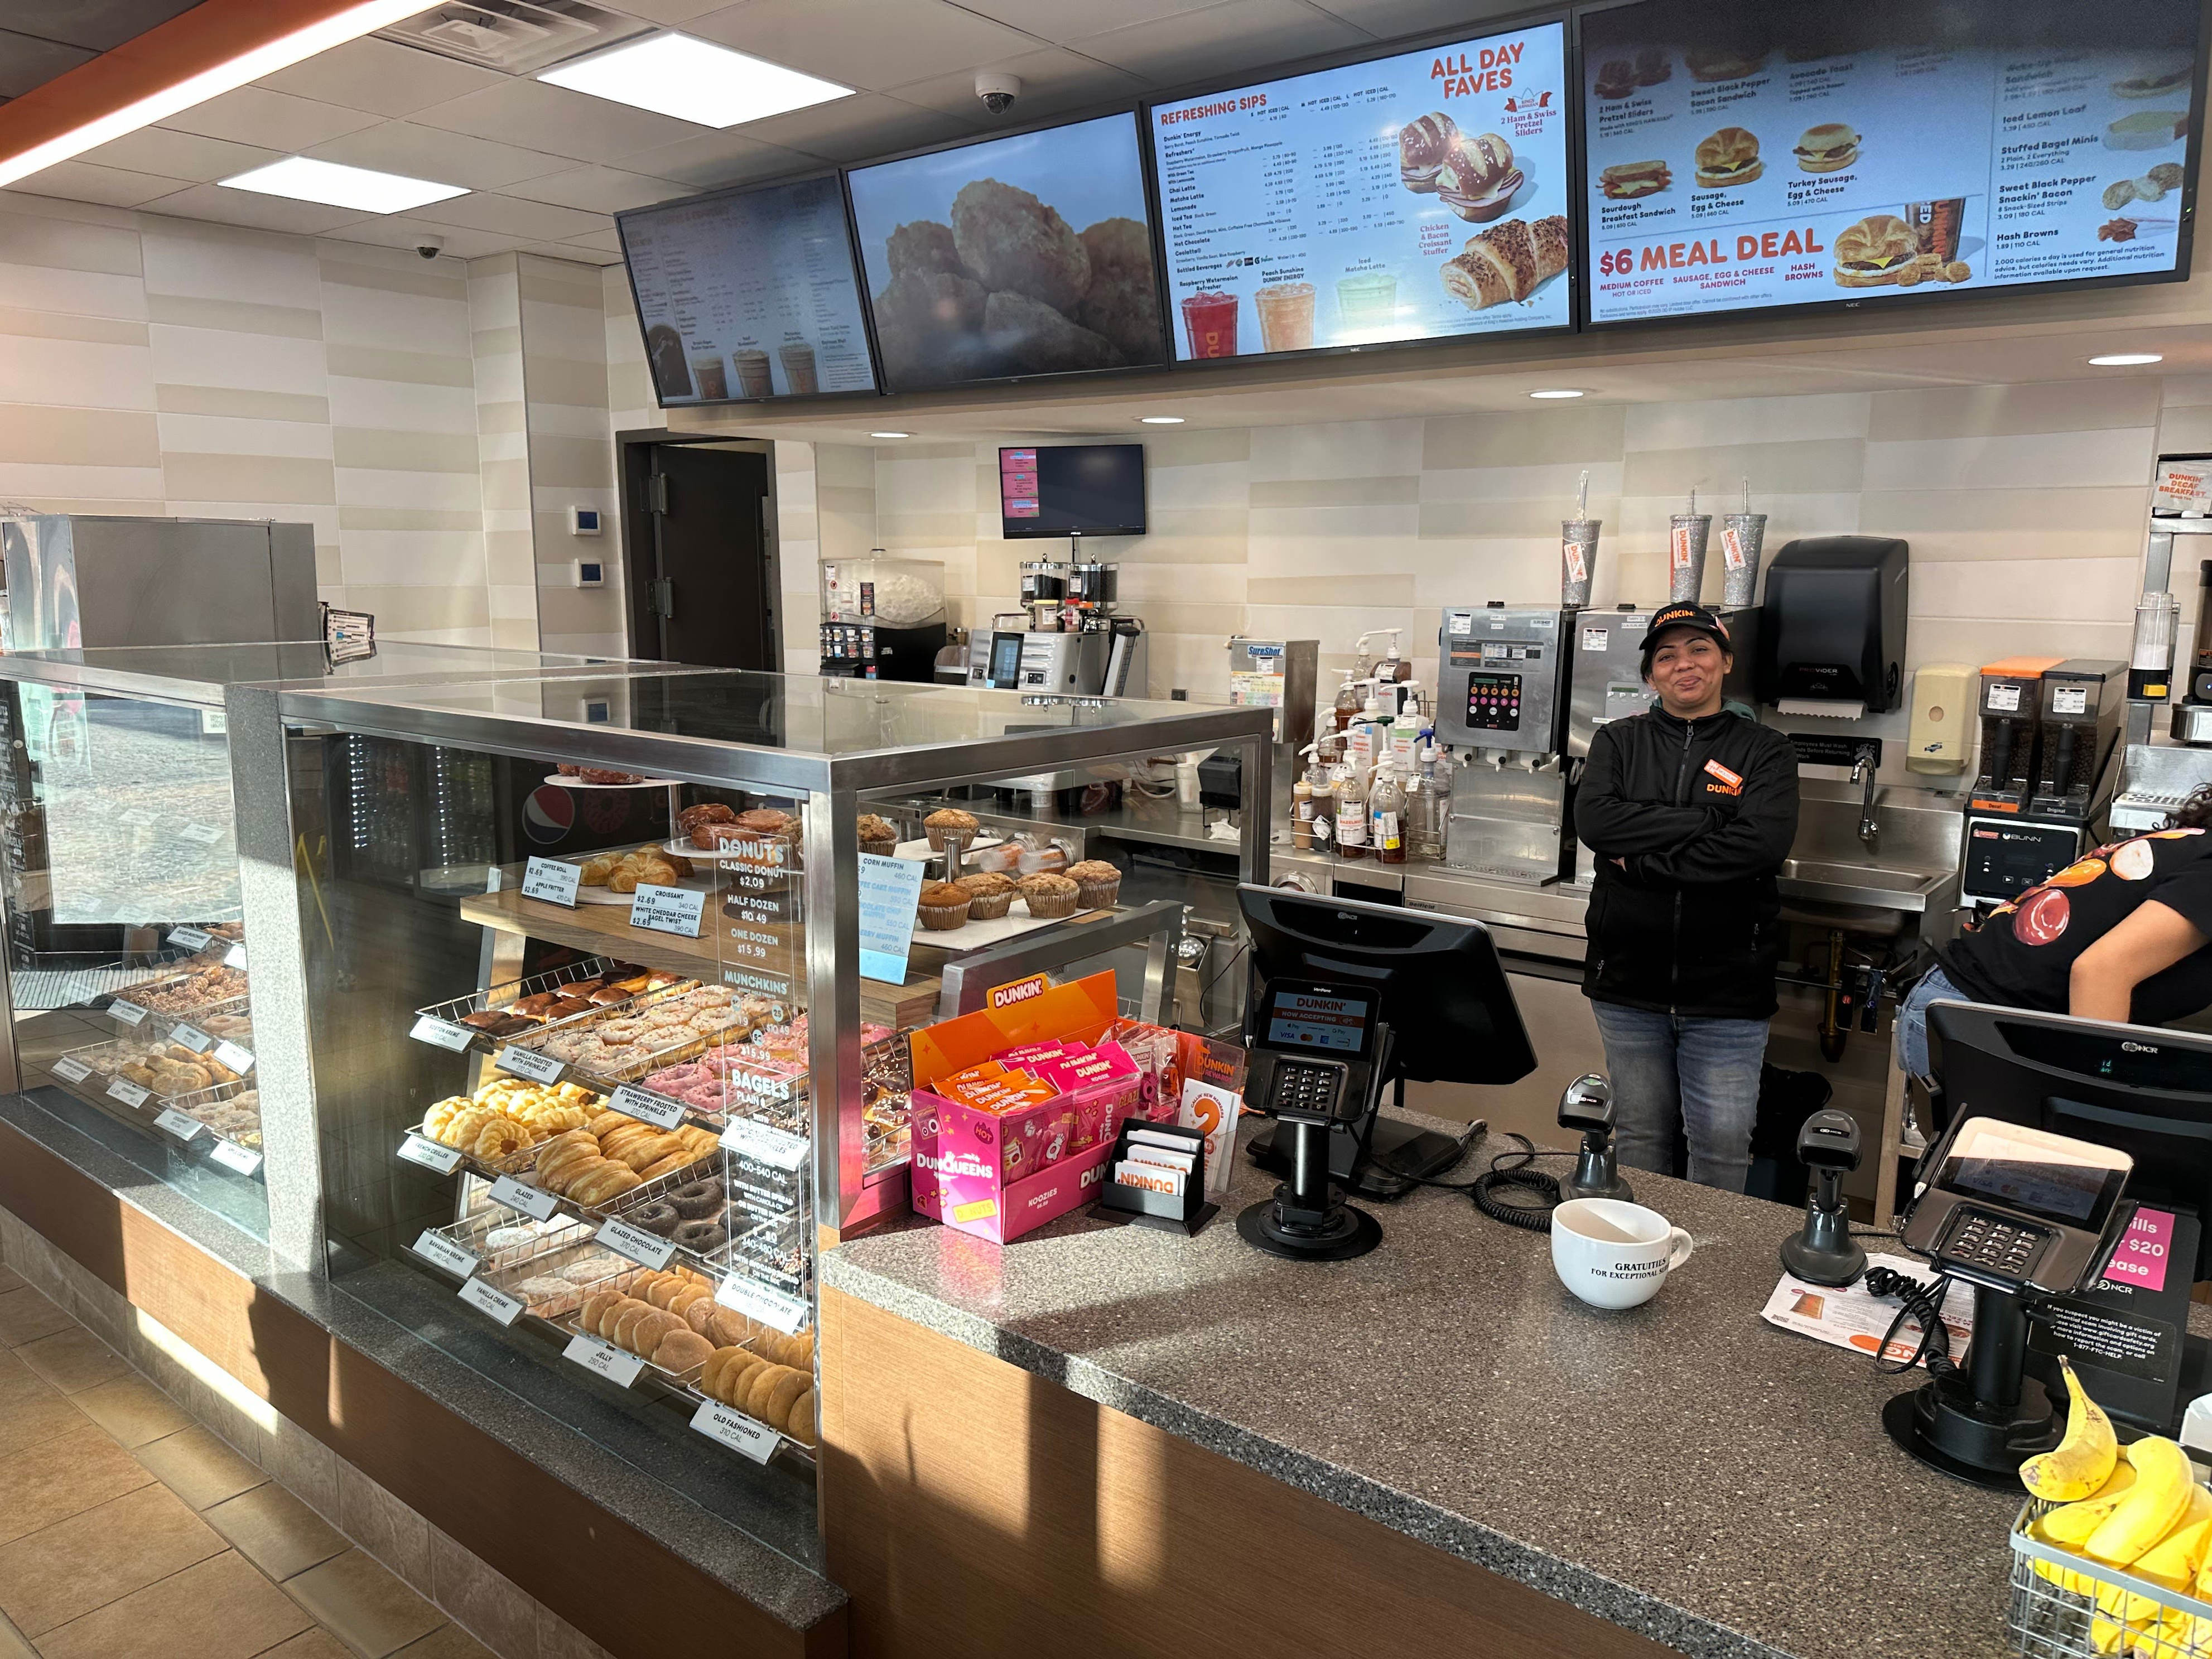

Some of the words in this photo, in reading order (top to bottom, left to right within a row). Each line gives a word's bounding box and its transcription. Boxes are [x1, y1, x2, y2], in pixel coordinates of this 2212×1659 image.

[1430, 54, 1473, 80] ALL
[1480, 42, 1525, 70] DAY
[1444, 68, 1512, 99] FAVES
[1161, 100, 1236, 126] REFRESHING
[1240, 94, 1267, 110] SIPS
[2003, 113, 2024, 123] Iced
[2026, 109, 2060, 120] Lemon
[2062, 104, 2087, 115] Loaf
[1514, 119, 1543, 129] Pretzel
[1515, 127, 1543, 137] Sliders
[2002, 142, 2040, 155] Stuffed
[2041, 139, 2069, 150] Bagel
[2072, 135, 2098, 145] Minis
[1788, 180, 1816, 190] Turkey
[1818, 175, 1857, 185] Sausage,
[1999, 182, 2029, 192] Sweet
[2031, 179, 2058, 189] Black
[2061, 175, 2097, 187] Pepper
[1691, 192, 1727, 201] Sausage,
[1787, 191, 1803, 200] Egg
[1814, 186, 1844, 195] Cheese
[1999, 193, 2039, 204] Snackin'
[2042, 189, 2073, 198] Bacon
[1601, 203, 1641, 214] Sourdough
[1716, 199, 1744, 208] Cheese
[1602, 213, 1638, 223] Breakfast
[1640, 208, 1675, 218] Sandwich
[1420, 224, 1449, 232] Chicken
[1997, 232, 2021, 242] Hash
[2023, 229, 2059, 239] Browns
[1419, 239, 1452, 248] Croissant
[1423, 247, 1448, 255] Stuffer
[1600, 248, 1633, 277] $6
[1640, 239, 1728, 272] MEAL
[1737, 228, 1824, 261] DEAL
[1791, 263, 1815, 272] HASH
[1673, 274, 1712, 283] SAUSAGE,
[1714, 271, 1732, 279] EGG
[1742, 267, 1775, 276] CHEESE
[1785, 271, 1823, 281] BROWNS
[1599, 282, 1631, 291] MEDIUM
[1633, 278, 1664, 287] COFFEE
[1700, 279, 1746, 290] SANDWICH
[2168, 473, 2204, 483] DUNKIN'
[2171, 481, 2199, 489] DECAF
[2158, 486, 2206, 498] BREAKFAST
[1249, 646, 1280, 656] SureShot
[719, 837, 783, 864] DONUTS
[720, 860, 753, 874] CLASSIC
[755, 866, 783, 879] DONUT
[881, 861, 904, 870] MUFFIN
[740, 876, 764, 888] $2.09
[637, 895, 655, 905] $2.69
[655, 890, 684, 900] CROISSANT
[727, 894, 748, 906] HALF
[750, 899, 779, 912] DOZEN
[648, 914, 664, 923] BAGEL
[652, 909, 677, 918] CHEDDAR
[677, 913, 697, 921] CHEESE
[731, 928, 748, 939] ONE
[749, 932, 778, 946] DOZEN
[725, 971, 788, 995] MUNCHKINS
[994, 979, 1043, 1008] DUNKIN'
[1297, 997, 1346, 1011] DUNKIN'
[1299, 1013, 1337, 1022] ACCEPTING
[2137, 1045, 2158, 1054] NCR
[512, 1057, 523, 1065] WITH
[523, 1060, 548, 1073] SPRINKLES
[513, 1050, 532, 1060] VANILLA
[532, 1057, 552, 1067] FROSTED
[1075, 1060, 1112, 1078] DUNKIN'
[1204, 1069, 1233, 1083] REWARDS
[732, 1069, 790, 1101] BAGELS
[620, 1089, 653, 1105] STRAWBERRY
[654, 1101, 677, 1112] FROSTED
[624, 1097, 638, 1106] WITH
[638, 1102, 667, 1116] SPRINKLES
[1213, 1097, 1224, 1118] MEMBERS
[975, 1127, 992, 1142] HOT
[917, 1151, 993, 1179] DUNQUEENS
[515, 1188, 533, 1200] GLAZED
[1028, 1187, 1058, 1207] KOOZIES
[610, 1226, 630, 1240] GLAZED
[630, 1236, 662, 1255] CHOCOLATE
[429, 1240, 450, 1255] BAVARIAN
[450, 1251, 465, 1263] KREME
[2129, 1239, 2164, 1257] $20
[1615, 1257, 1666, 1271] GRATUITIES
[1591, 1269, 1607, 1277] FOR
[1609, 1270, 1658, 1280] EXCEPTIONAL
[2111, 1284, 2133, 1294] NCR
[2065, 1309, 2088, 1319] suspect
[2100, 1318, 2118, 1327] might
[2134, 1327, 2153, 1335] victim
[2098, 1324, 2124, 1335] involving
[2138, 1334, 2158, 1343] cards.
[2073, 1330, 2108, 1343] information
[2122, 1343, 2145, 1353] options
[2075, 1338, 2094, 1346] report
[596, 1351, 613, 1362] JELLY
[714, 1413, 726, 1424] OLD
[725, 1419, 760, 1440] FASHIONED
